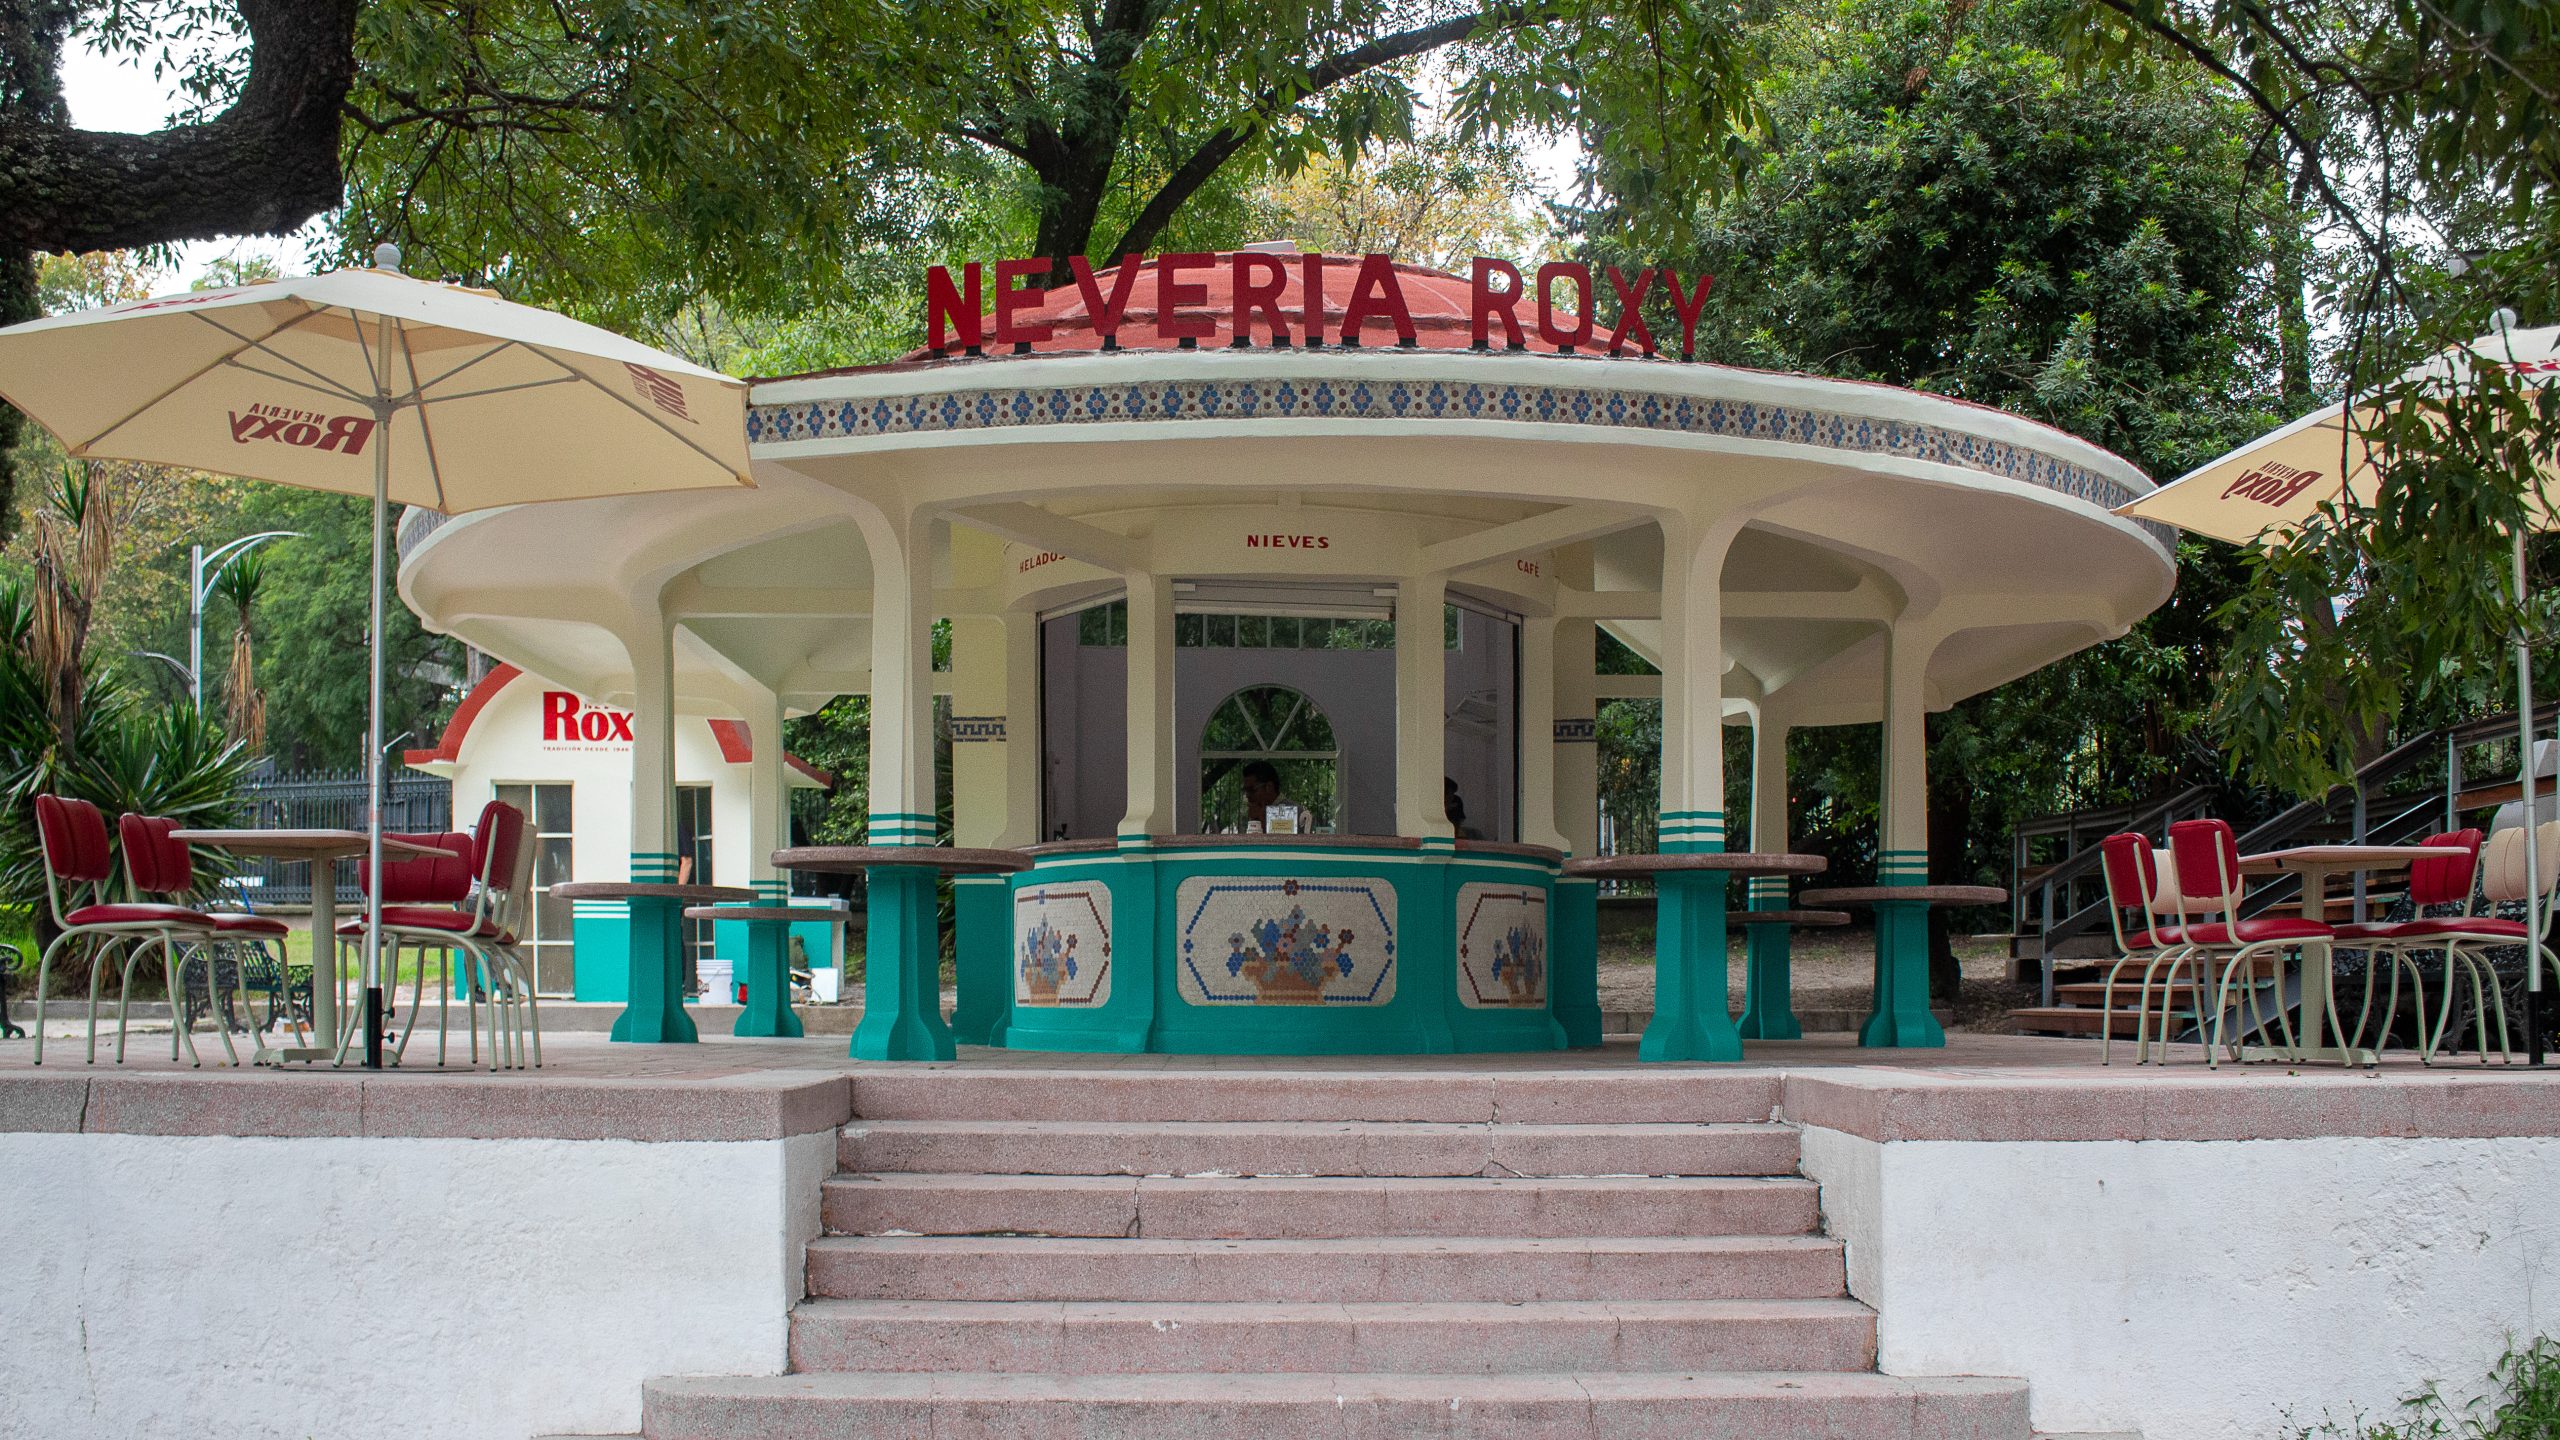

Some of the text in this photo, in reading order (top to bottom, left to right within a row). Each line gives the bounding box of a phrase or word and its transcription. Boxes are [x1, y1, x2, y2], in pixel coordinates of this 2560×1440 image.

[927, 252, 1714, 354] NEVERIA ROXY
[1247, 534, 1329, 549] NIEVES
[1517, 559, 1540, 578] CAFÉ
[543, 691, 634, 742] Rox
